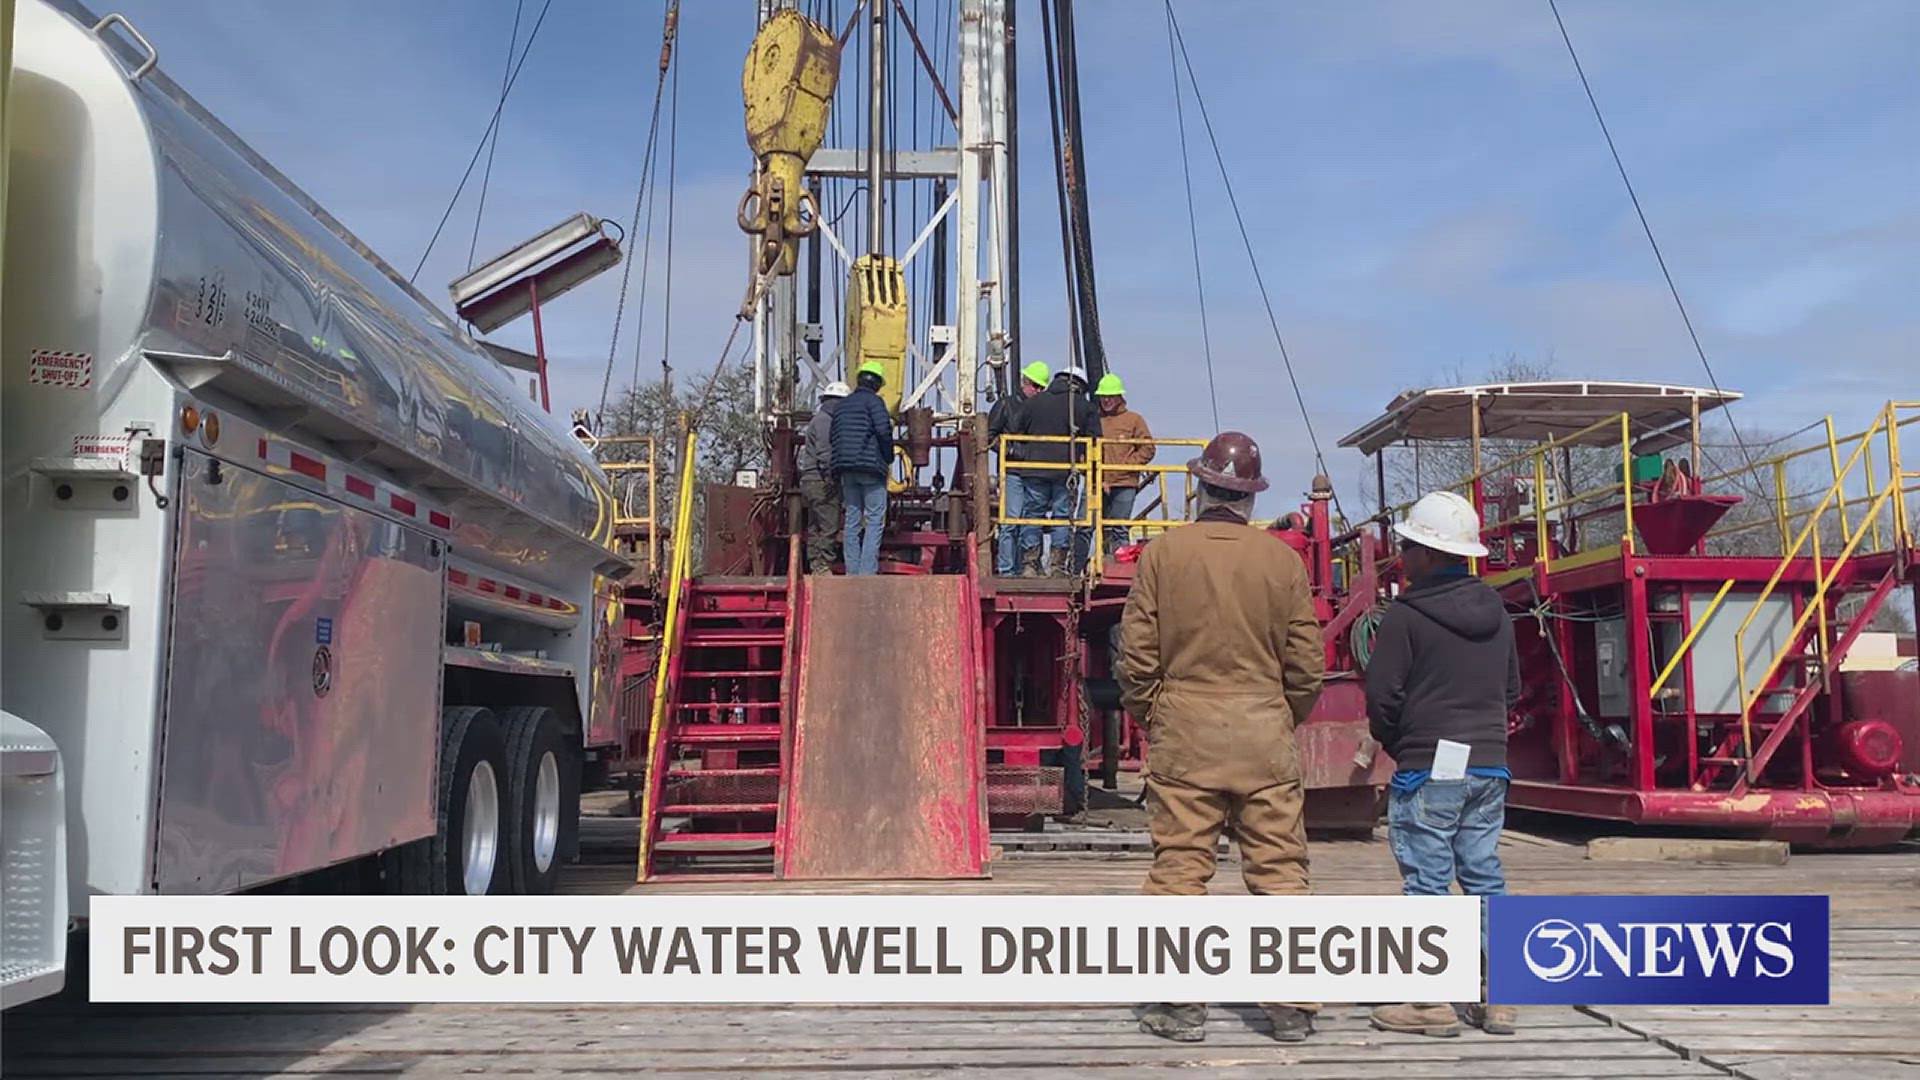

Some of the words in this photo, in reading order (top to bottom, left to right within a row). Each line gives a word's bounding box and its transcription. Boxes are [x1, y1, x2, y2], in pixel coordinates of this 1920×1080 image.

[37, 355, 84, 370] EMERGENCY
[41, 368, 80, 381] SHUT-OFF
[79, 445, 125, 455] EMERGENCY
